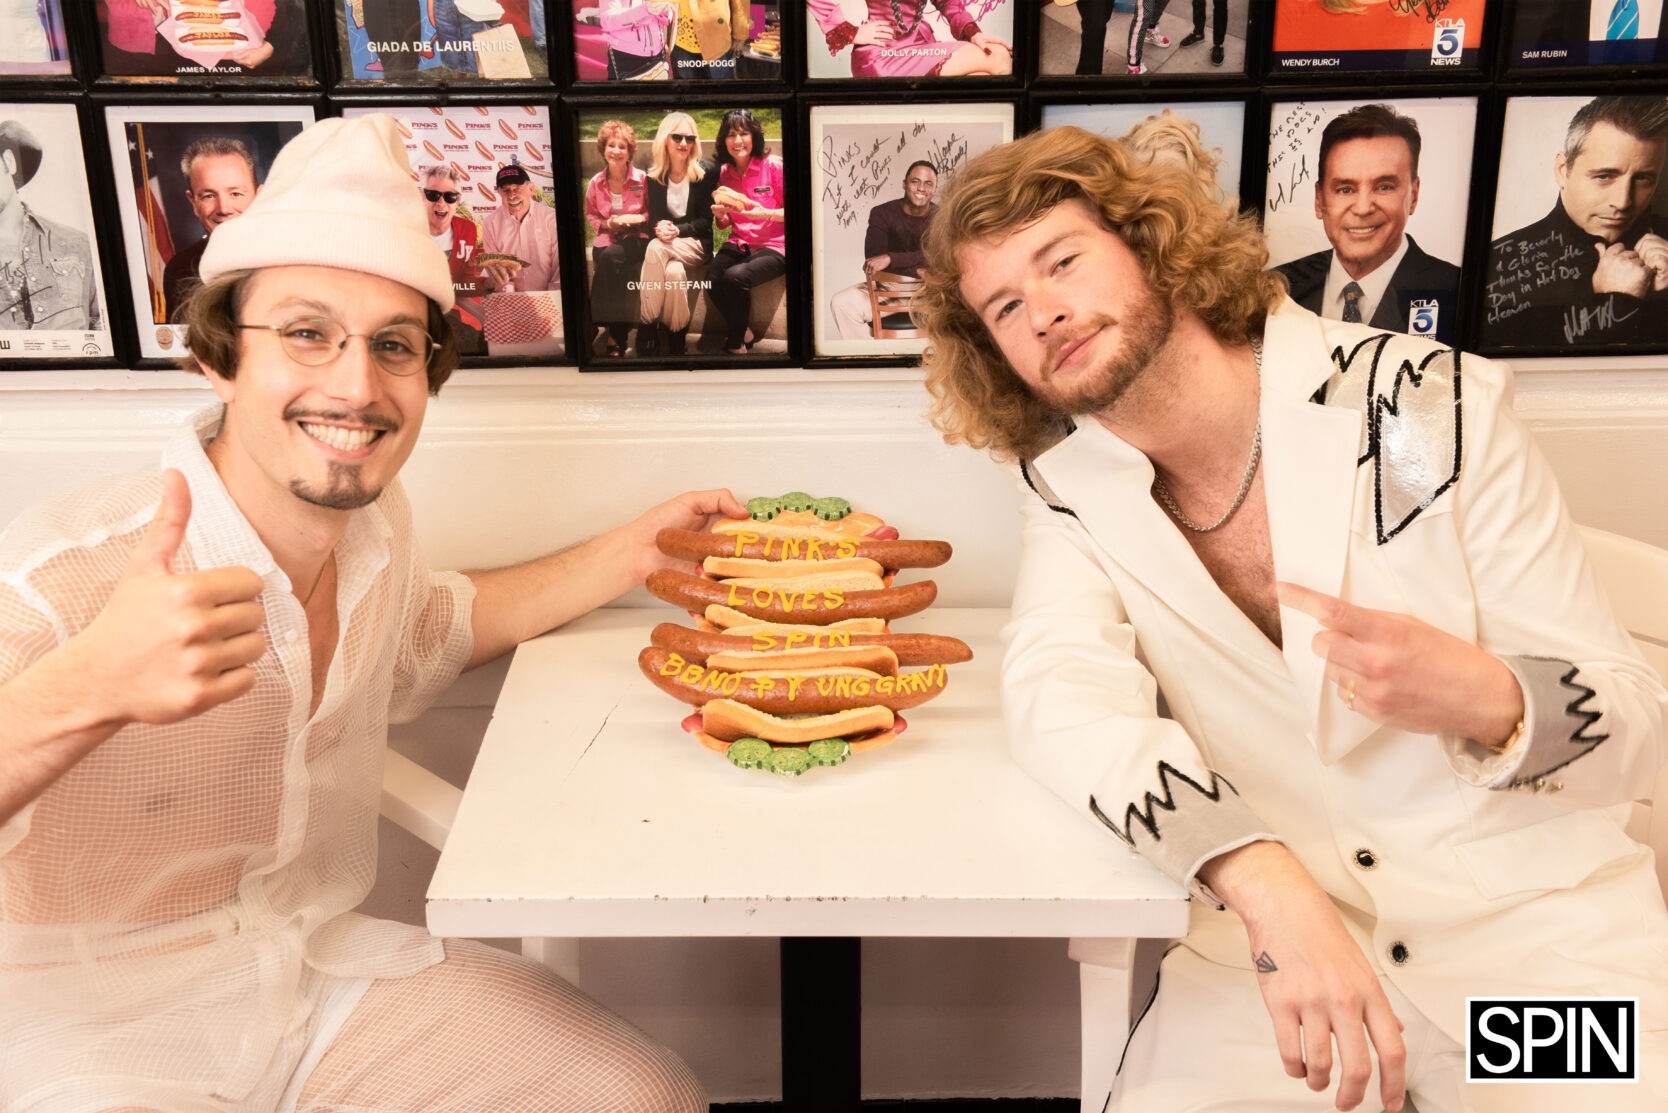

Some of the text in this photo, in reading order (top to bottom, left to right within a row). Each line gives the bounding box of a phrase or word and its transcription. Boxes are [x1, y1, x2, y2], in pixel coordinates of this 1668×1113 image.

[1434, 18, 1466, 28] KTLA
[366, 40, 515, 53] GIADA DE LAURENTIIS
[1436, 29, 1460, 56] 5
[881, 48, 948, 57] DOLLY PARTON
[1521, 49, 1568, 59] SAM RUBIN
[677, 59, 735, 68] SNOOP DOGG
[1281, 58, 1340, 67] WENDY BURCH
[1430, 57, 1462, 66] NEWS
[175, 66, 242, 74] JAMES TAYLOR
[1493, 239, 1514, 255] To
[452, 282, 476, 291] VILLE
[626, 280, 712, 291] GWEN STEFANI
[1410, 299, 1439, 308] KTLA
[1412, 308, 1434, 333] 5
[726, 531, 861, 560] PINK'S
[728, 582, 845, 612] LOVES
[751, 631, 852, 651] SPIN
[875, 663, 947, 696] GRAVY
